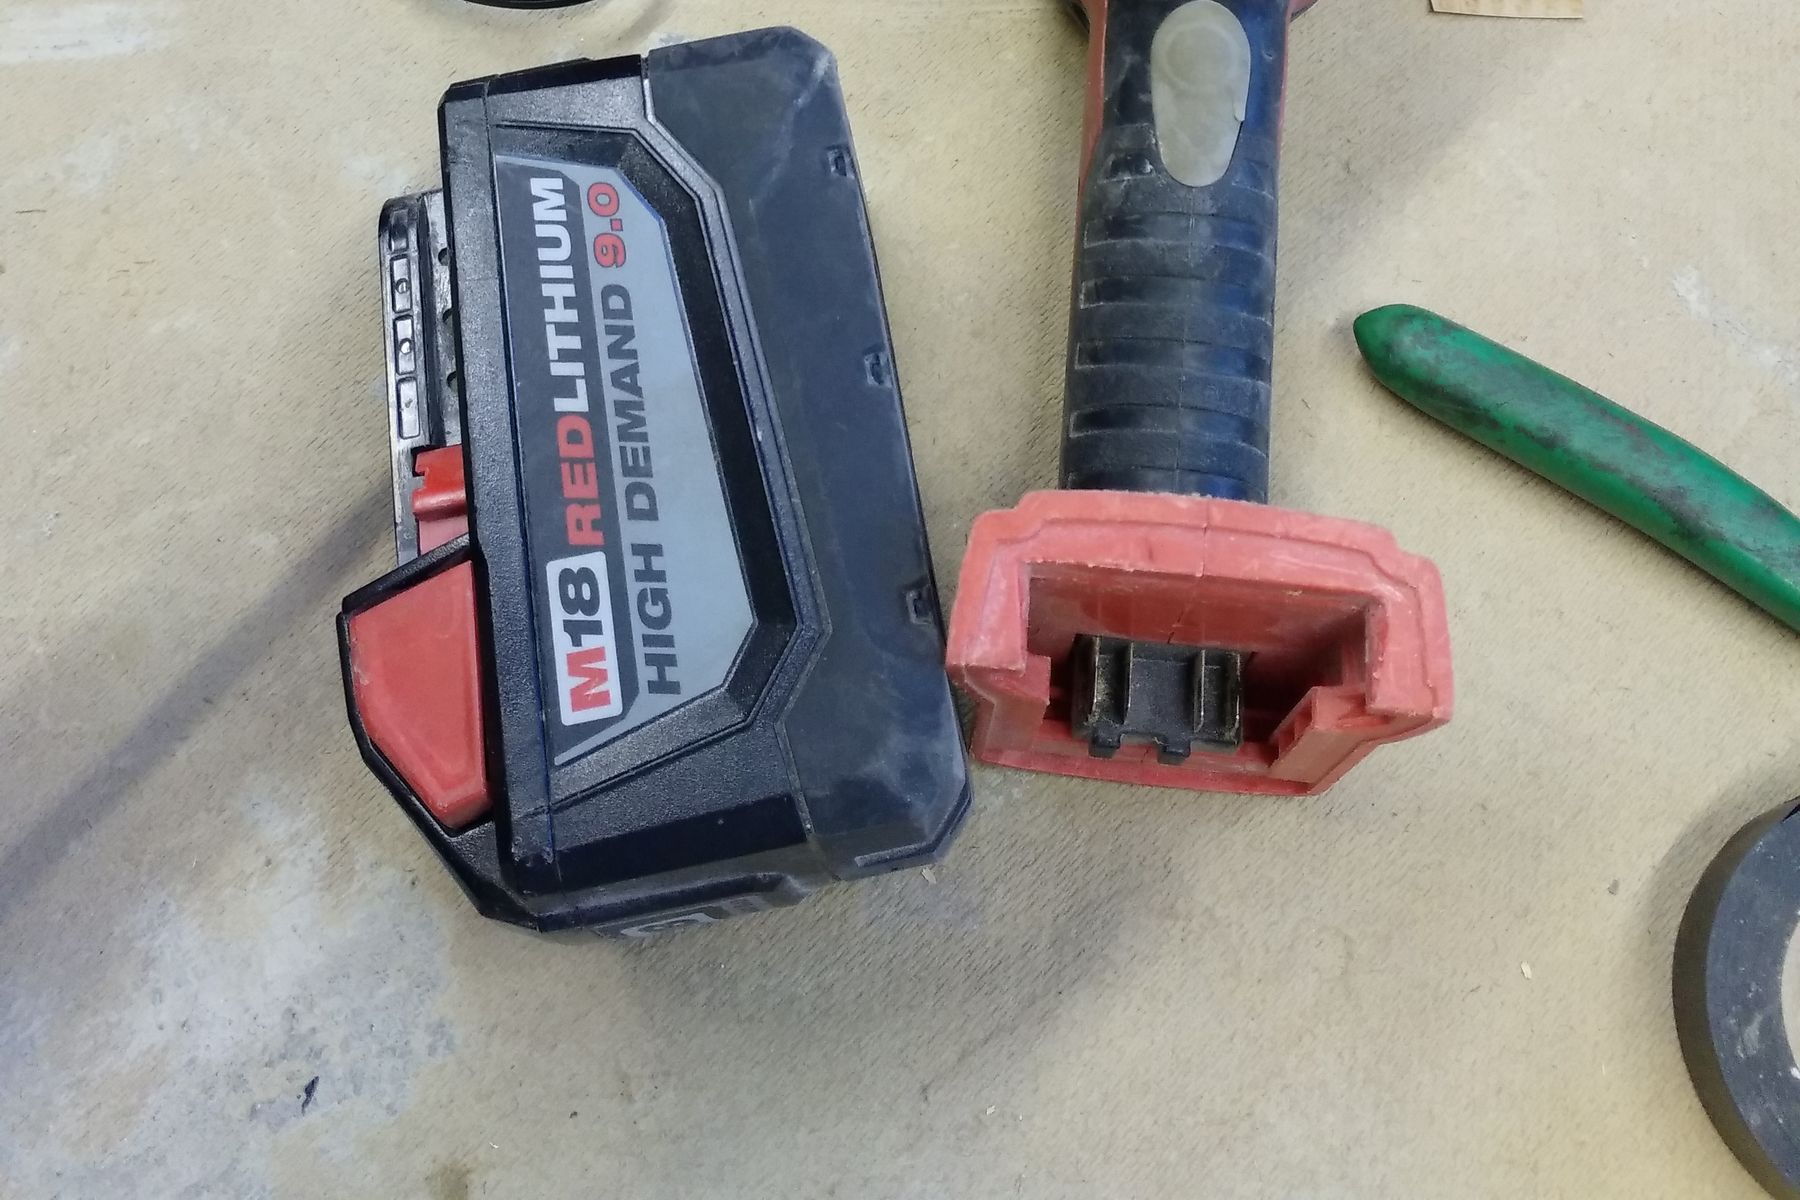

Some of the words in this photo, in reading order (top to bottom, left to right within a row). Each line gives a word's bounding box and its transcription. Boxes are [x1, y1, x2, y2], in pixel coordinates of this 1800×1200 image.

[586, 181, 627, 269] 9.0
[530, 177, 605, 546] REDLITHIUM
[600, 283, 660, 522] DEMAND
[557, 566, 612, 713] M18
[630, 543, 682, 696] HIGH
